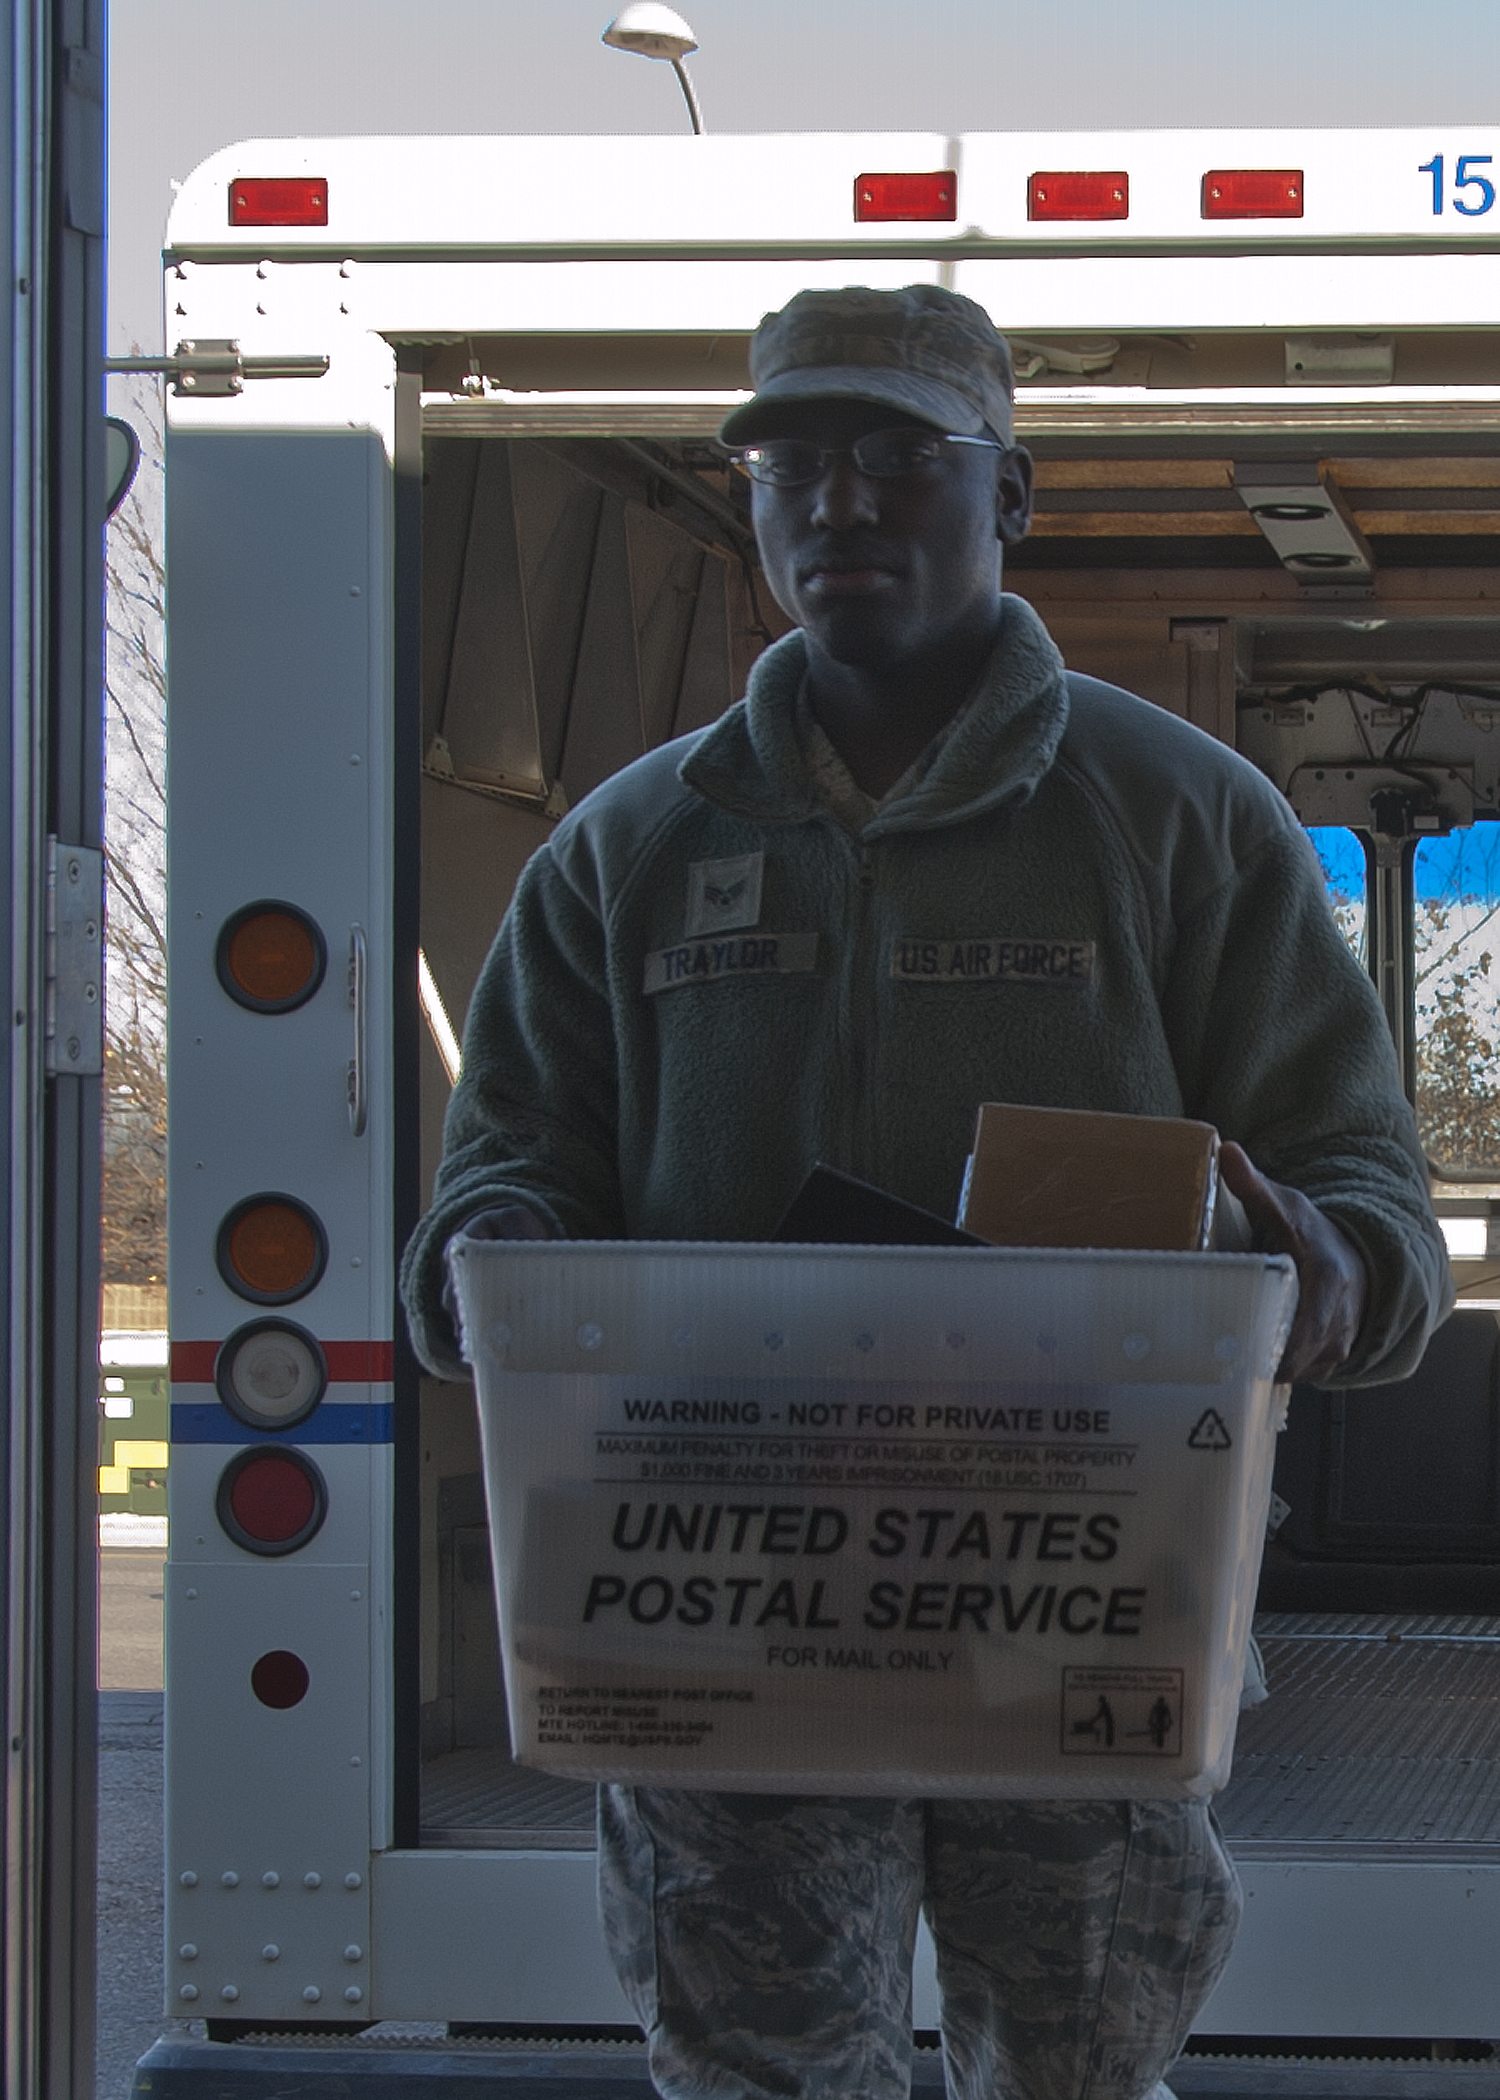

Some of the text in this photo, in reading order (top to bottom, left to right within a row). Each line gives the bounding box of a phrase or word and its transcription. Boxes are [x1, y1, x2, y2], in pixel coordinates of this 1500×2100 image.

[1418, 154, 1495, 216] 15
[662, 938, 779, 981] TRAYLOR
[949, 943, 991, 976] AIR
[997, 943, 1084, 978] FORCE
[623, 1399, 761, 1424] WARNING
[788, 1403, 847, 1426] NOT
[857, 1404, 916, 1428] FOR
[926, 1406, 1043, 1431] PRIVATE
[1053, 1410, 1111, 1433] USE
[596, 1438, 1136, 1467] MAXIMUM PENALTY FOR THEFT OR MISUSE OF POSTAL PROPERTY
[694, 1462, 730, 1479] FINE
[734, 1463, 771, 1480] AND
[786, 1464, 843, 1481] YEARS
[847, 1466, 974, 1484] IMPRISONMENT
[1005, 1470, 1042, 1486] USC
[612, 1502, 1122, 1564] UNITED STATES
[581, 1574, 1148, 1638] POSTAL SERVICE
[767, 1645, 954, 1672] FOR MAIL ONLY
[539, 1704, 556, 1716] TO
[594, 1687, 610, 1699] TO
[673, 1688, 707, 1701] POST
